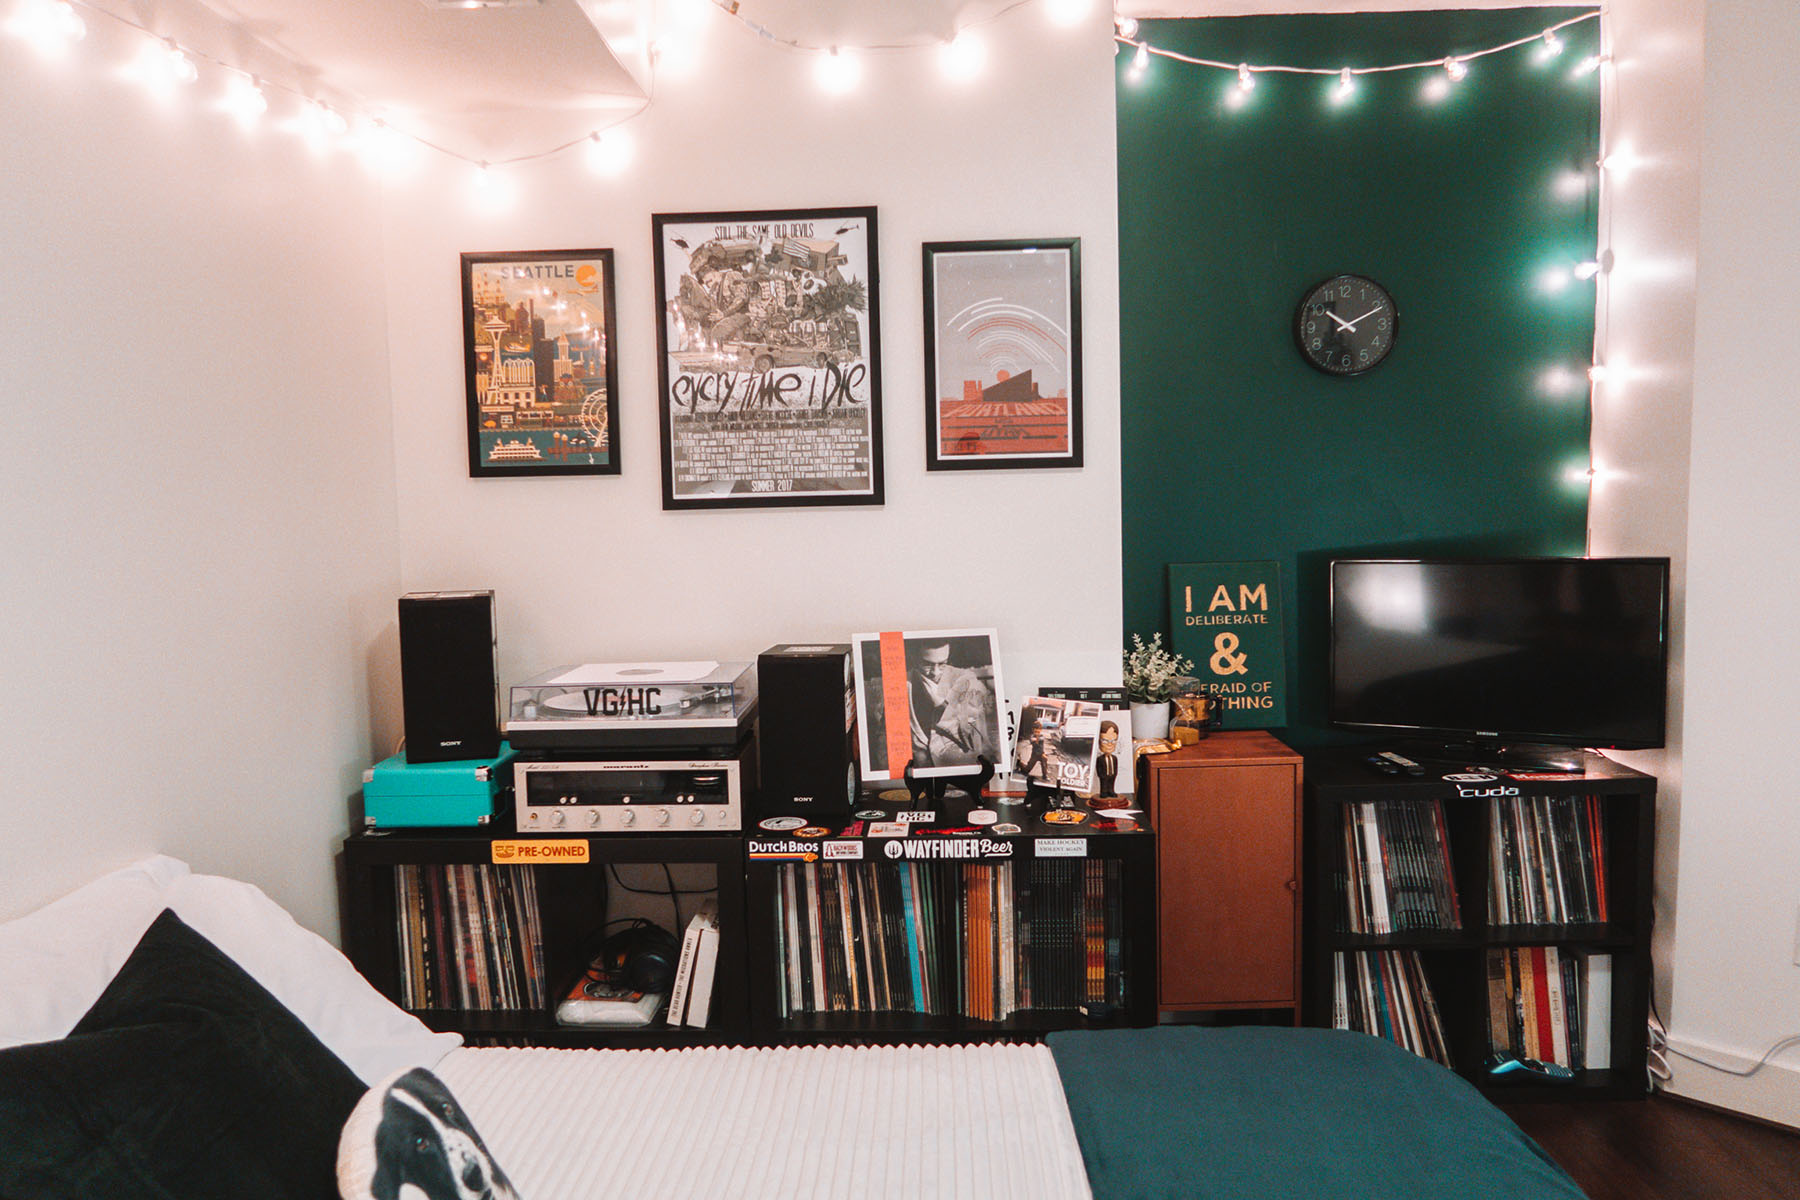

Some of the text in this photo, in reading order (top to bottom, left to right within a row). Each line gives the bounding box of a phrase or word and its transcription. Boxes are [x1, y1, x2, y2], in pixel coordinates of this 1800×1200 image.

[715, 223, 814, 241] STILL THE SAME OLD DEVILS
[501, 265, 575, 279] SEATTLE
[1324, 290, 1335, 302] 11
[1339, 285, 1352, 298] 12
[1360, 288, 1366, 301] 1
[1311, 303, 1326, 317] 10
[1372, 300, 1381, 310] 2
[1306, 321, 1316, 334] 9
[1377, 318, 1387, 331] 3
[1312, 338, 1322, 351] 8
[1371, 336, 1380, 347] 4
[1325, 351, 1334, 363] 7
[1342, 354, 1351, 367] 6
[1360, 349, 1369, 362] 5
[942, 402, 1066, 418] PORTLAND
[751, 479, 793, 492] SUMMER 2017
[1185, 583, 1269, 613] I AM
[1185, 614, 1269, 626] DELIBERATE
[1209, 632, 1249, 676] &
[1250, 681, 1273, 693] OF
[1056, 761, 1089, 780] TOY
[518, 846, 586, 857] PRE-OWNED
[902, 839, 1014, 858] WAYFINDER Beer
